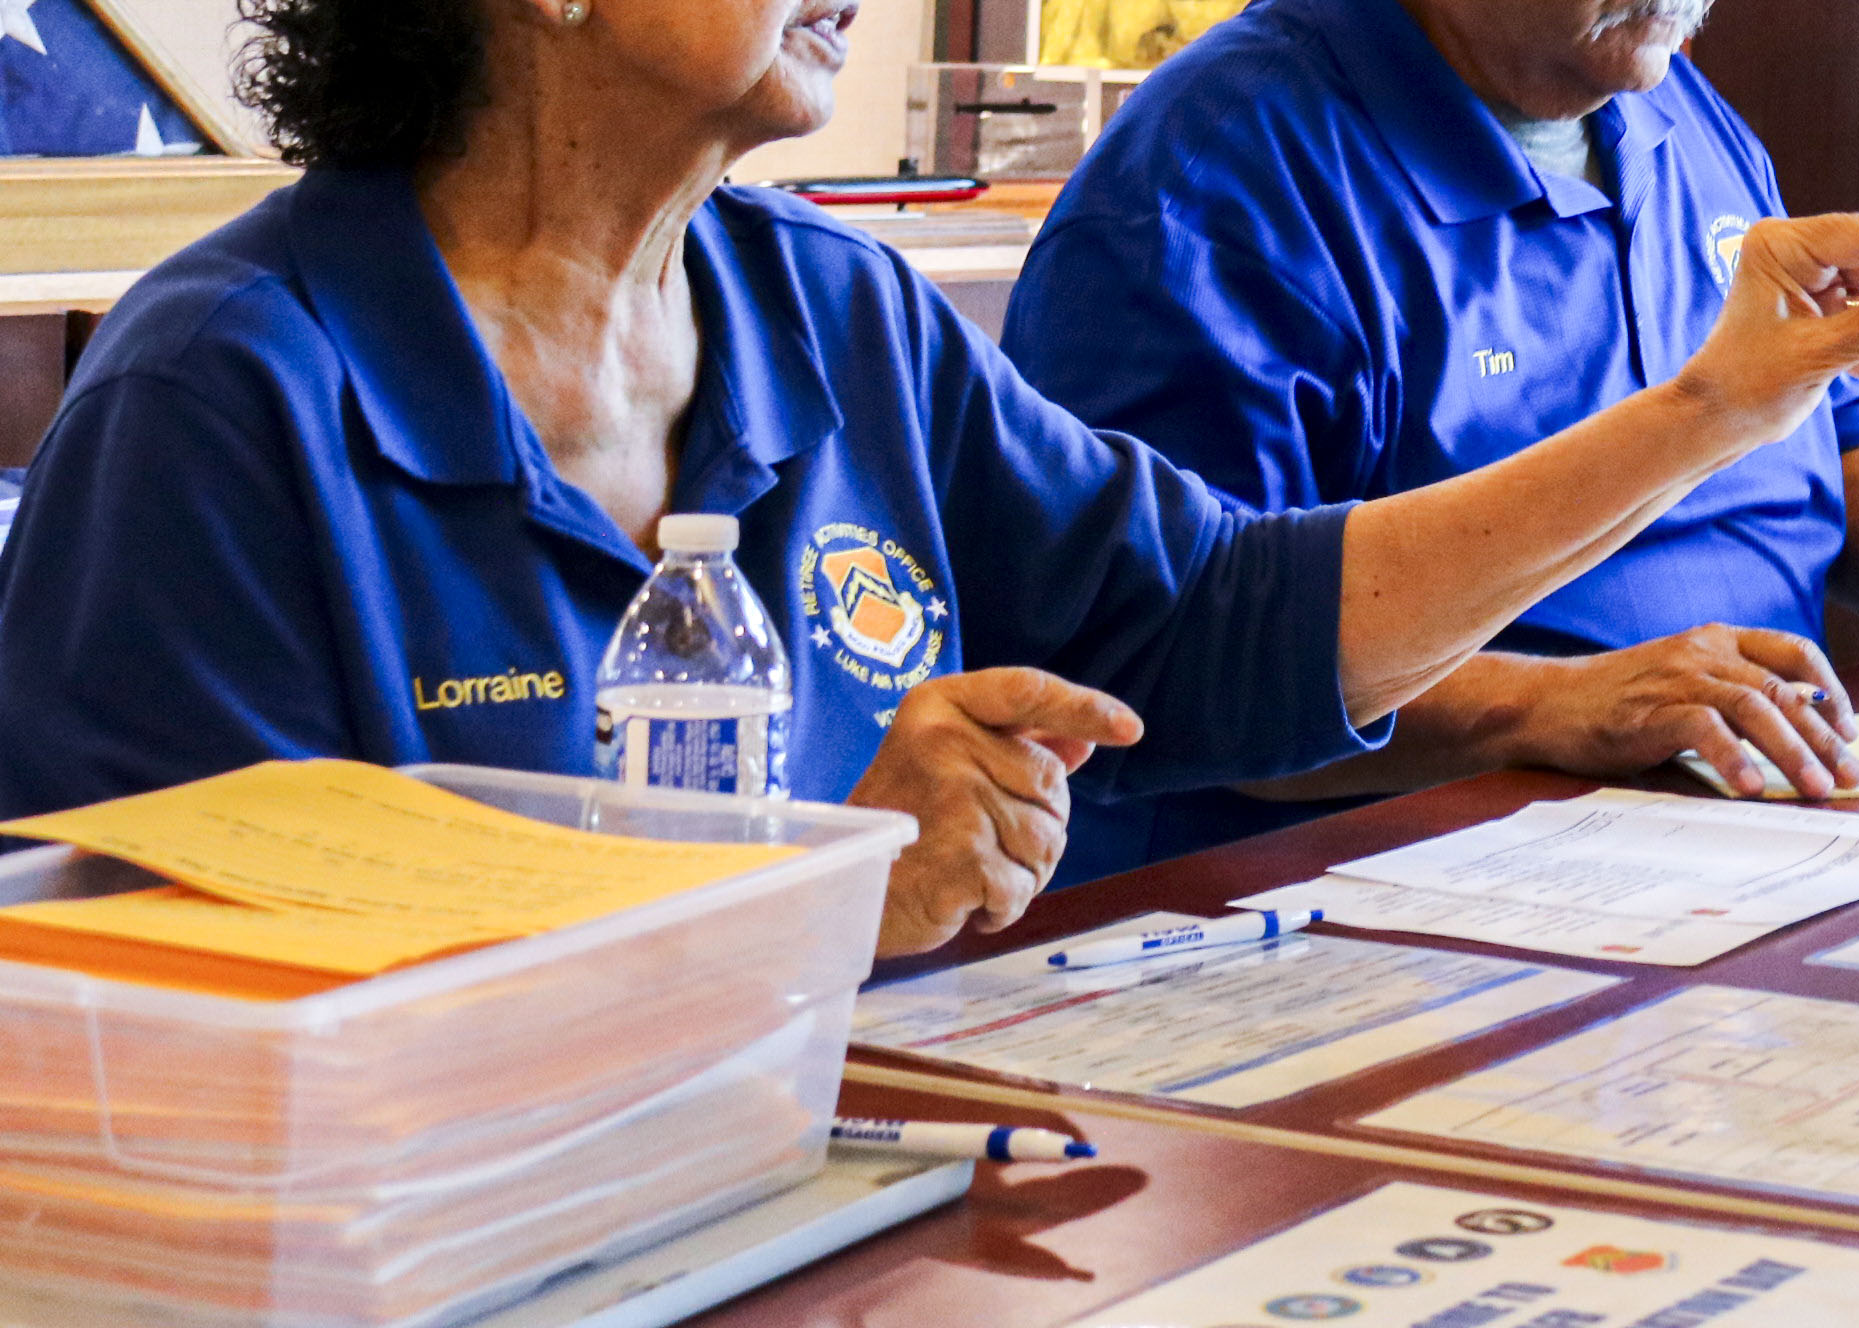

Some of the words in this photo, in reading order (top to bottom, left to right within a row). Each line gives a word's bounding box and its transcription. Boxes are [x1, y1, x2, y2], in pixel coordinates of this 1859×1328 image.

[1473, 347, 1515, 378] Tim
[881, 539, 934, 592] OFFICE
[414, 666, 565, 711] Lorraine
